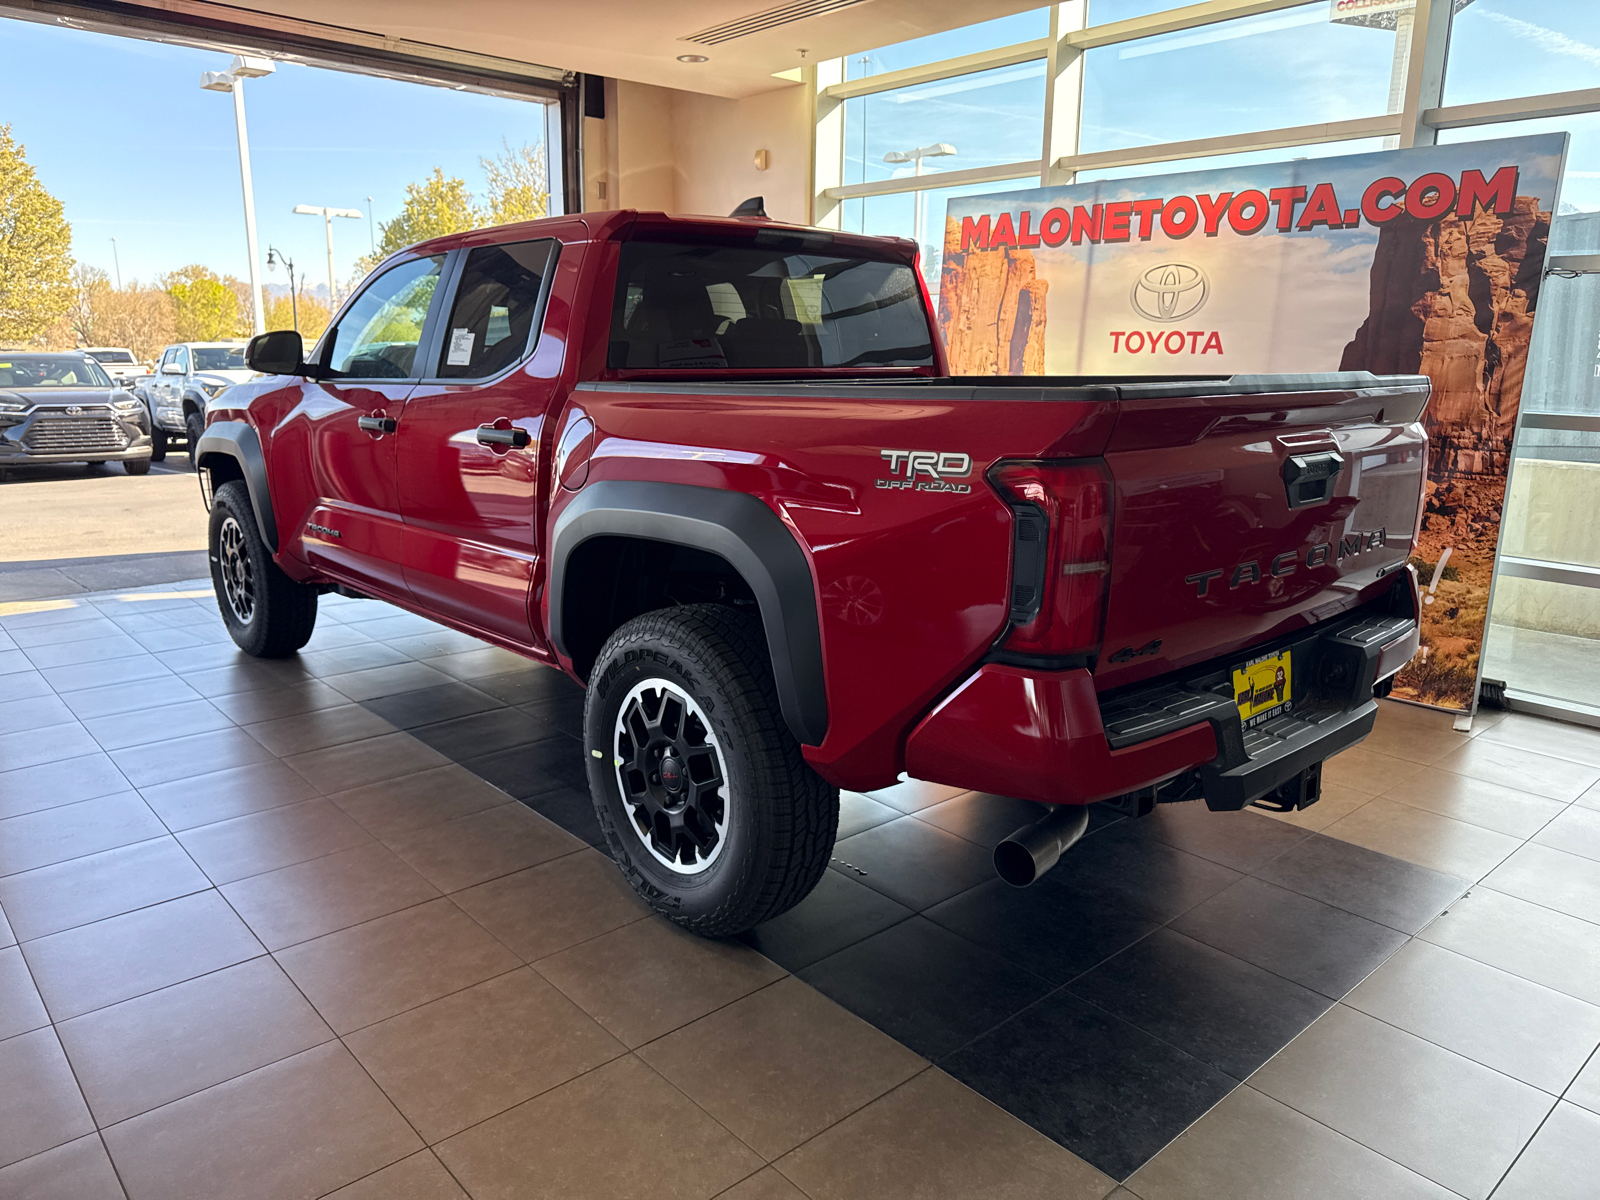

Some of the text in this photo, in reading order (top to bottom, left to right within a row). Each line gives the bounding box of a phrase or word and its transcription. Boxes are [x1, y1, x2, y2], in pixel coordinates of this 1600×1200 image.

[1337, 0, 1404, 11] COLLIS
[960, 166, 1520, 252] MALONETOYOTA.COM
[1109, 331, 1224, 355] TOYOTA
[880, 449, 973, 482] TRD
[1306, 461, 1330, 475] TOYOTA
[875, 479, 972, 493] OFF ROAD
[306, 522, 342, 538] TACOMA
[1185, 527, 1387, 598] TACOMA
[597, 649, 701, 699] WILDPEAK
[1276, 670, 1283, 681] 32
[1249, 718, 1256, 728] WE
[1256, 713, 1267, 725] MAKE
[1272, 706, 1282, 718] EASY
